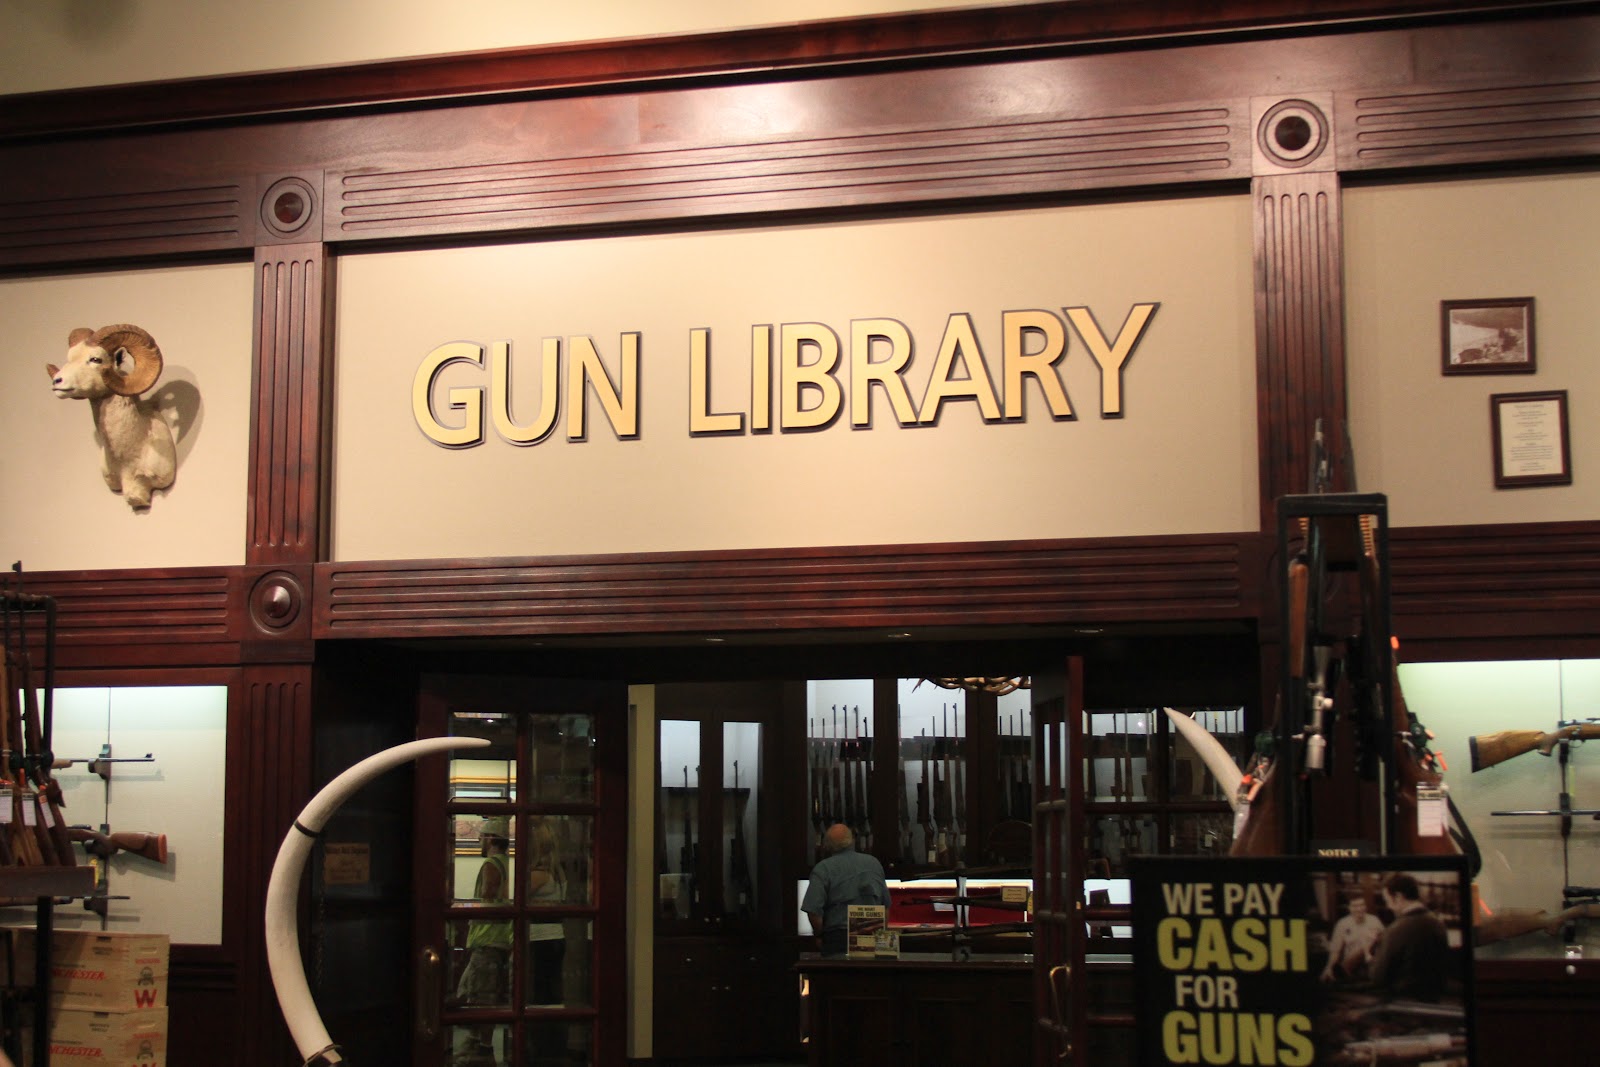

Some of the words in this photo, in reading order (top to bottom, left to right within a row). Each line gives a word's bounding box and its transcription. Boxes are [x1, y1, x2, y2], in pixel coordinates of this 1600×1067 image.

[411, 330, 643, 450] GUN
[688, 302, 1161, 438] LIBRARY
[1318, 849, 1359, 858] NOTICE
[1161, 883, 1214, 915] WE
[1223, 883, 1285, 915] PAY
[1157, 917, 1308, 972] CASH
[134, 989, 157, 1008] W
[1175, 975, 1238, 1008] FOR
[1162, 1010, 1314, 1067] GUNS
